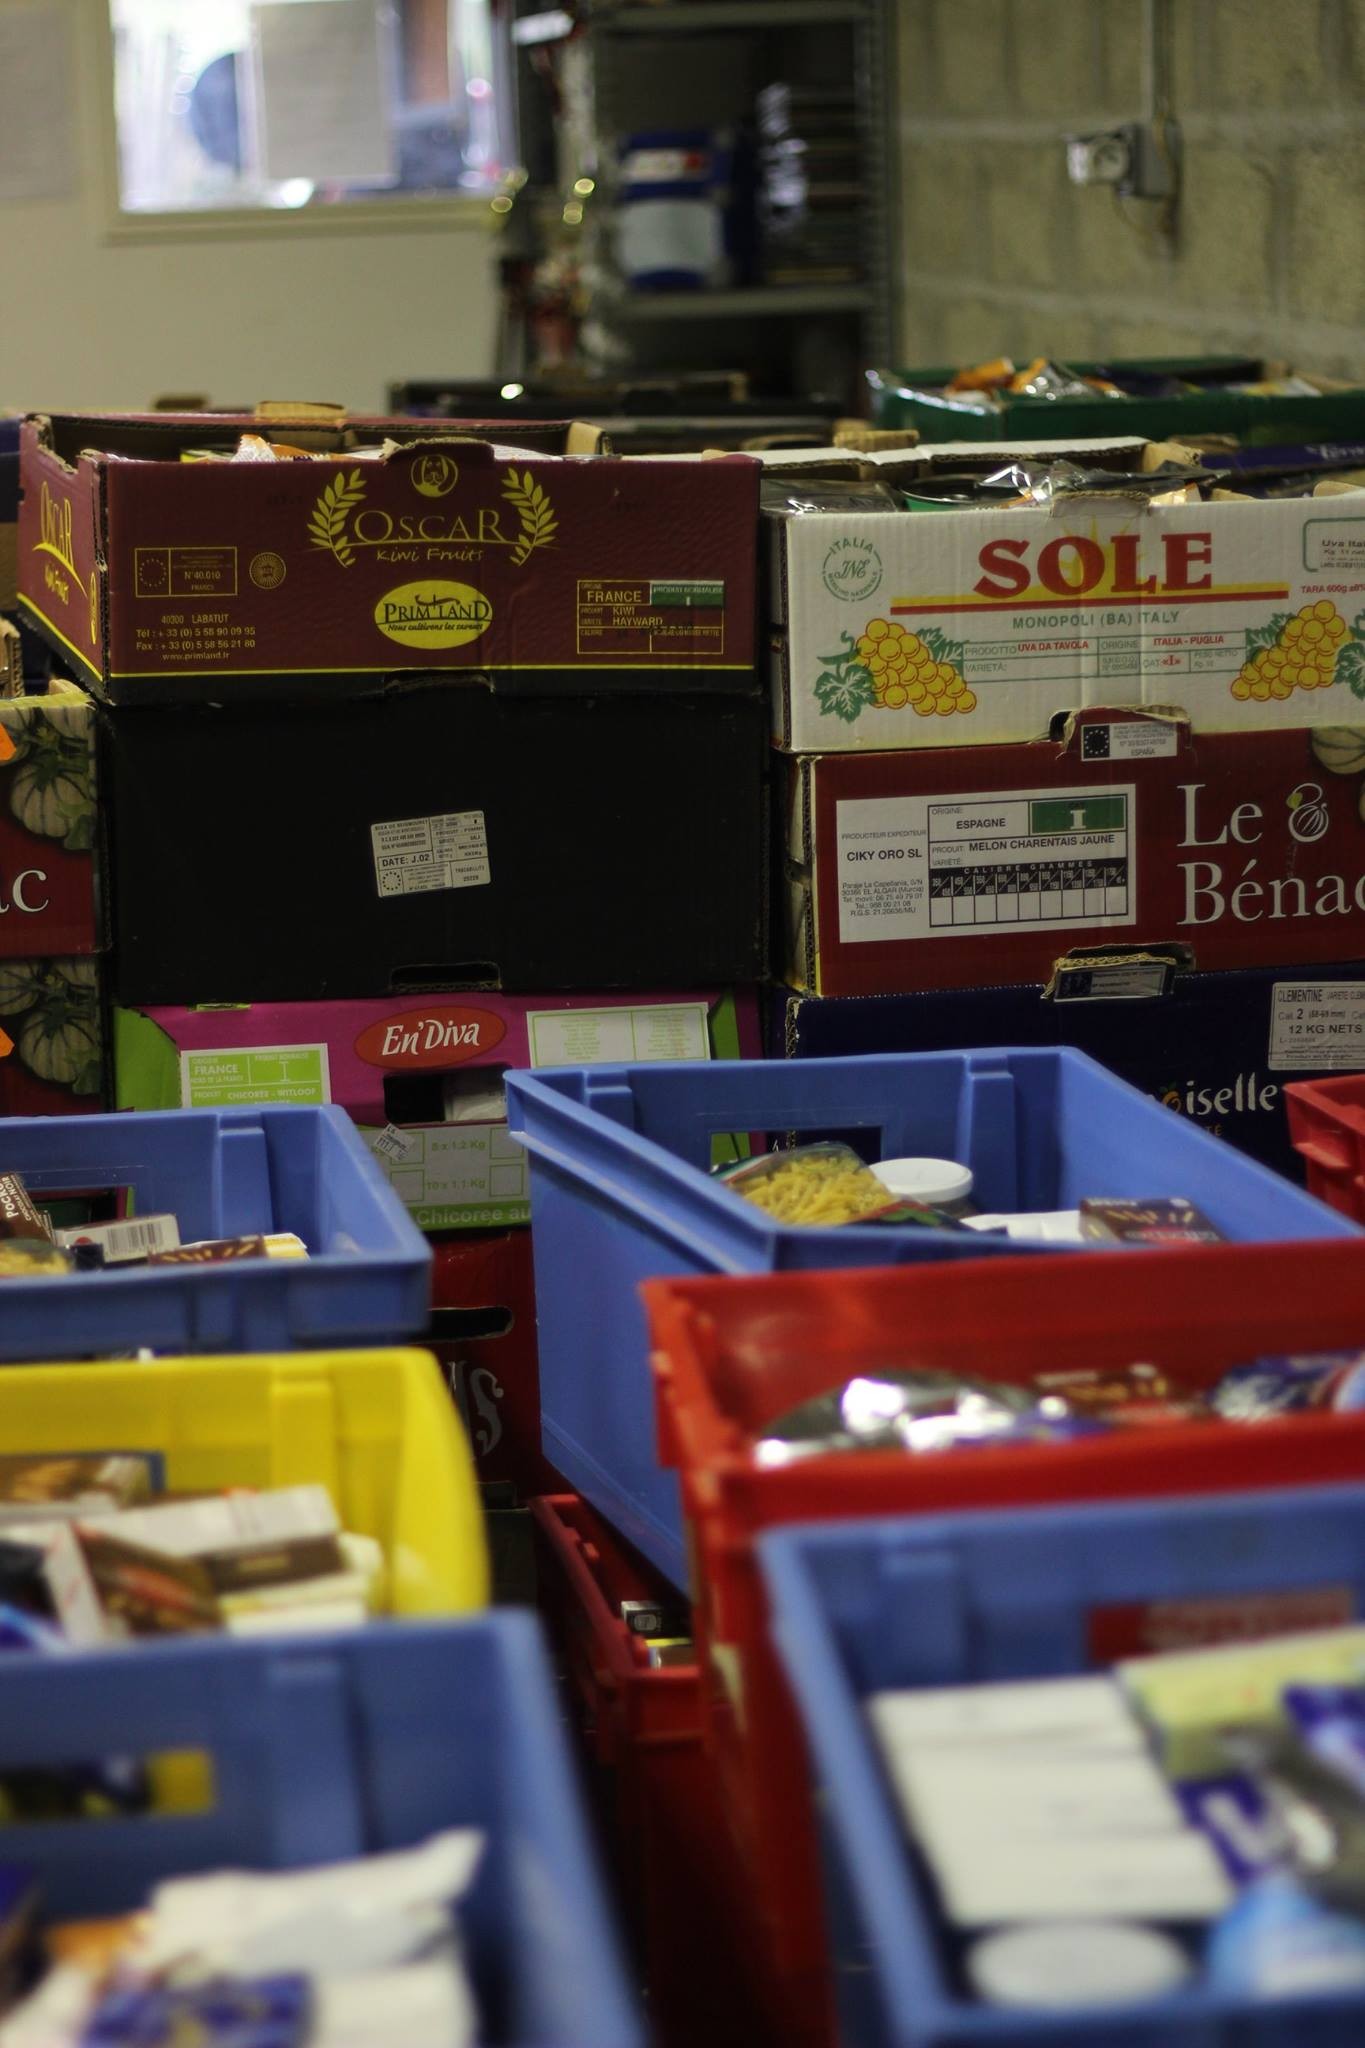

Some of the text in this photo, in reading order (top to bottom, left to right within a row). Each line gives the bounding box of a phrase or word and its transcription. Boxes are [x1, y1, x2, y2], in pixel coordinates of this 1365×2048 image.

[353, 508, 510, 544] OSCAR
[829, 537, 874, 555] ITALIA
[376, 546, 485, 561] Kiwi Fruits
[973, 532, 1213, 600] SOLE
[1301, 585, 1326, 593] TARA
[586, 590, 642, 603] FRANCE
[612, 606, 636, 616] KIWI
[191, 613, 230, 624] LABATUT
[612, 616, 664, 627] HAYWARD
[1012, 610, 1181, 631] MONOPOLI (BA) ITALY
[136, 642, 153, 651] Fax
[1152, 637, 1181, 647] ITALIA
[1190, 635, 1225, 645] PUGLIA
[964, 639, 1089, 658] PRODOTTO UVA DA TAVOLA
[1176, 784, 1264, 848] Le
[956, 817, 1007, 831] ESPAGNE
[968, 840, 1009, 853] MELON
[1009, 835, 1078, 851] CHARENTAIS
[1079, 834, 1116, 847] JAUNE
[382, 853, 430, 867] DATE: J.02
[846, 848, 923, 862] CIKY ORO SL
[963, 860, 1094, 875] CALIBRE GRAMMES
[1278, 989, 1323, 1003] CLEMENTINE
[1296, 1008, 1304, 1020] 2
[1288, 1023, 1363, 1034] 12 KG NETS
[381, 1018, 481, 1056] En'Diva
[195, 1063, 240, 1075] FRANCE
